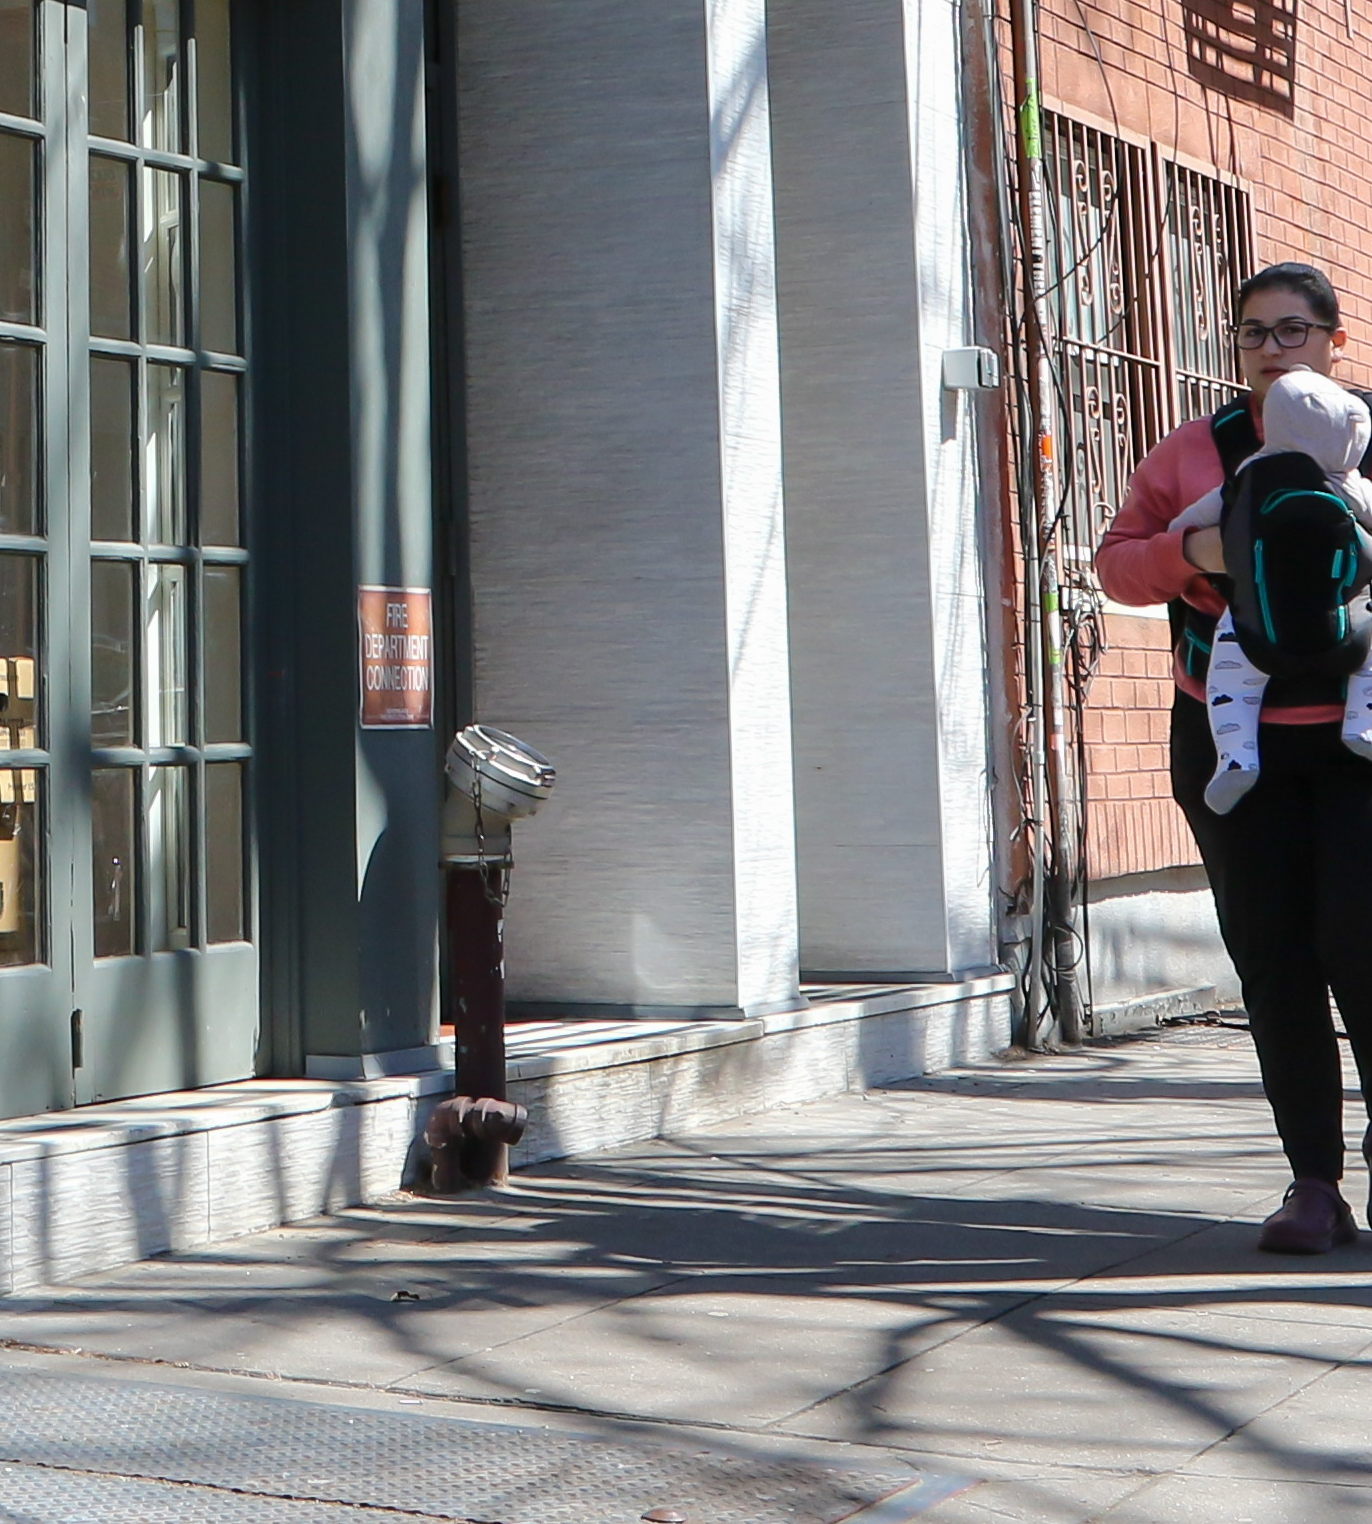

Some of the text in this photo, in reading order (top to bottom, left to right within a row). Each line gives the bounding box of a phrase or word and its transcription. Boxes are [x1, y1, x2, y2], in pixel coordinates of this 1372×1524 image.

[387, 603, 409, 628] FIRE
[365, 634, 429, 660] DEPARTMENT
[367, 665, 429, 691] CONNECTION
